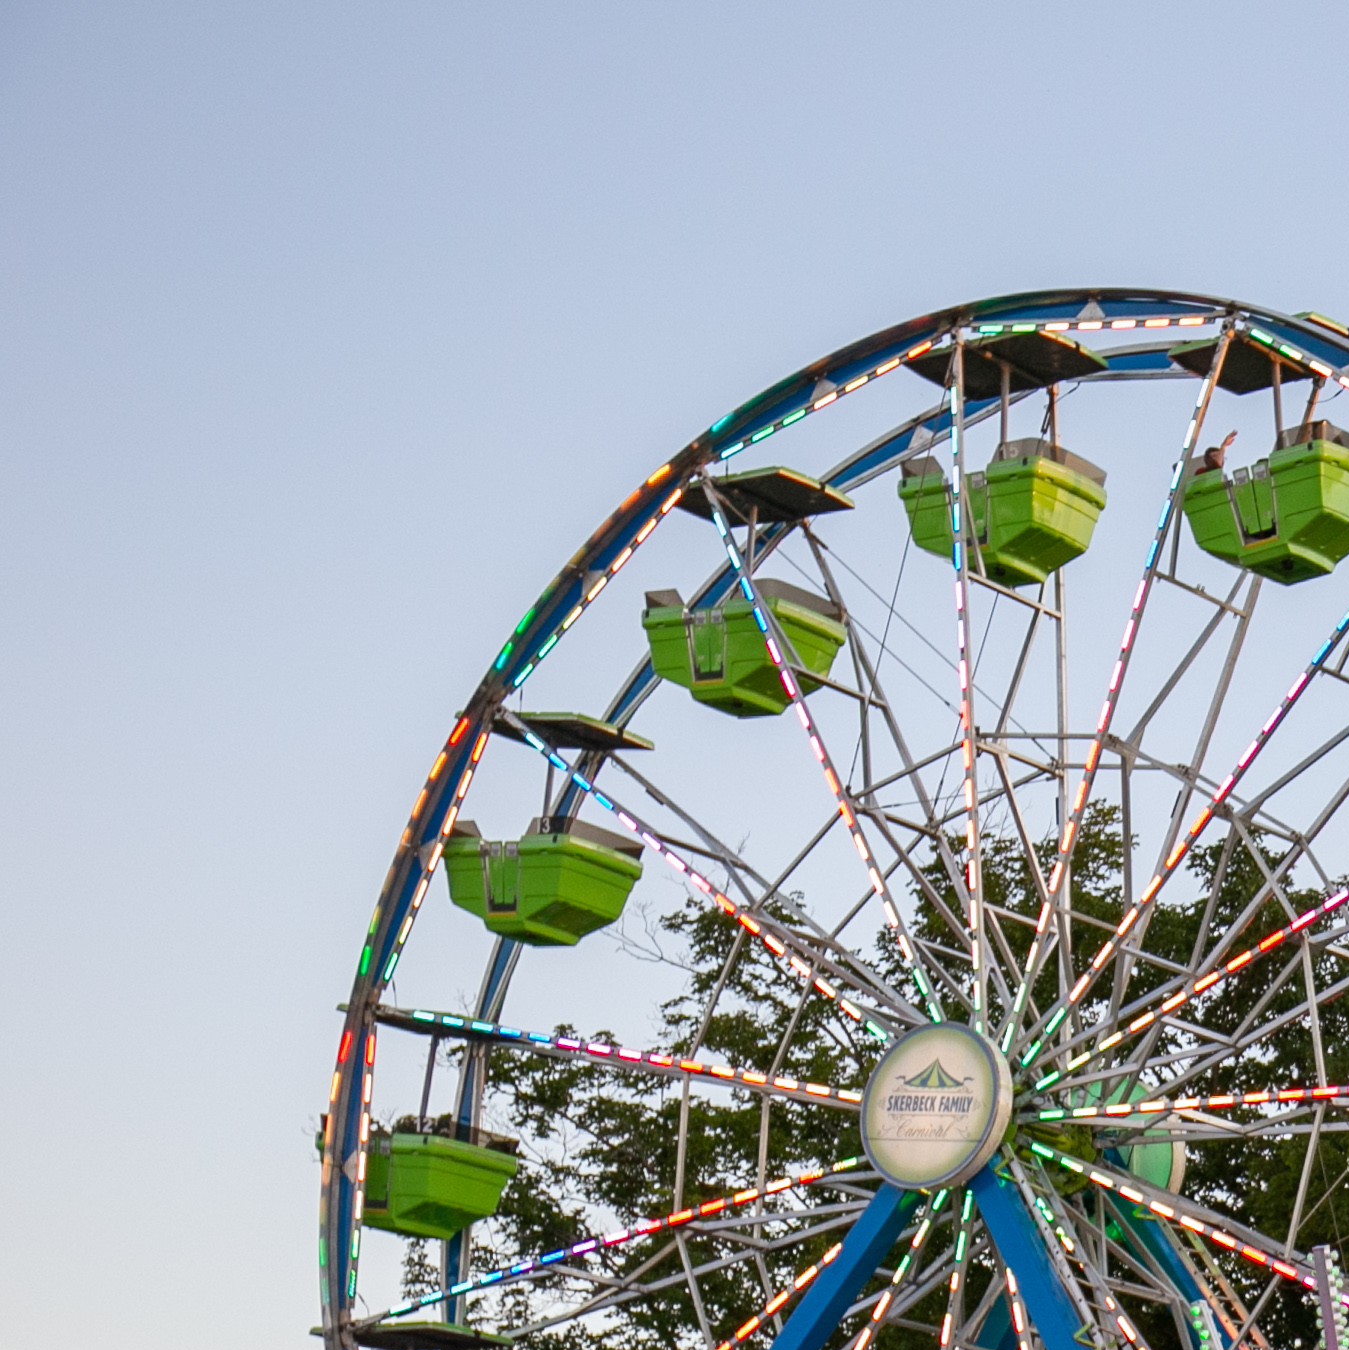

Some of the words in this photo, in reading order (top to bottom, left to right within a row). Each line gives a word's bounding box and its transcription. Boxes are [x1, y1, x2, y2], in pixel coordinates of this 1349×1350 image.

[536, 817, 551, 834] 13
[886, 1095, 936, 1113] SKERBECK
[938, 1095, 973, 1113] FAMILY
[413, 1117, 433, 1133] 12
[895, 1117, 955, 1138] Carnival
